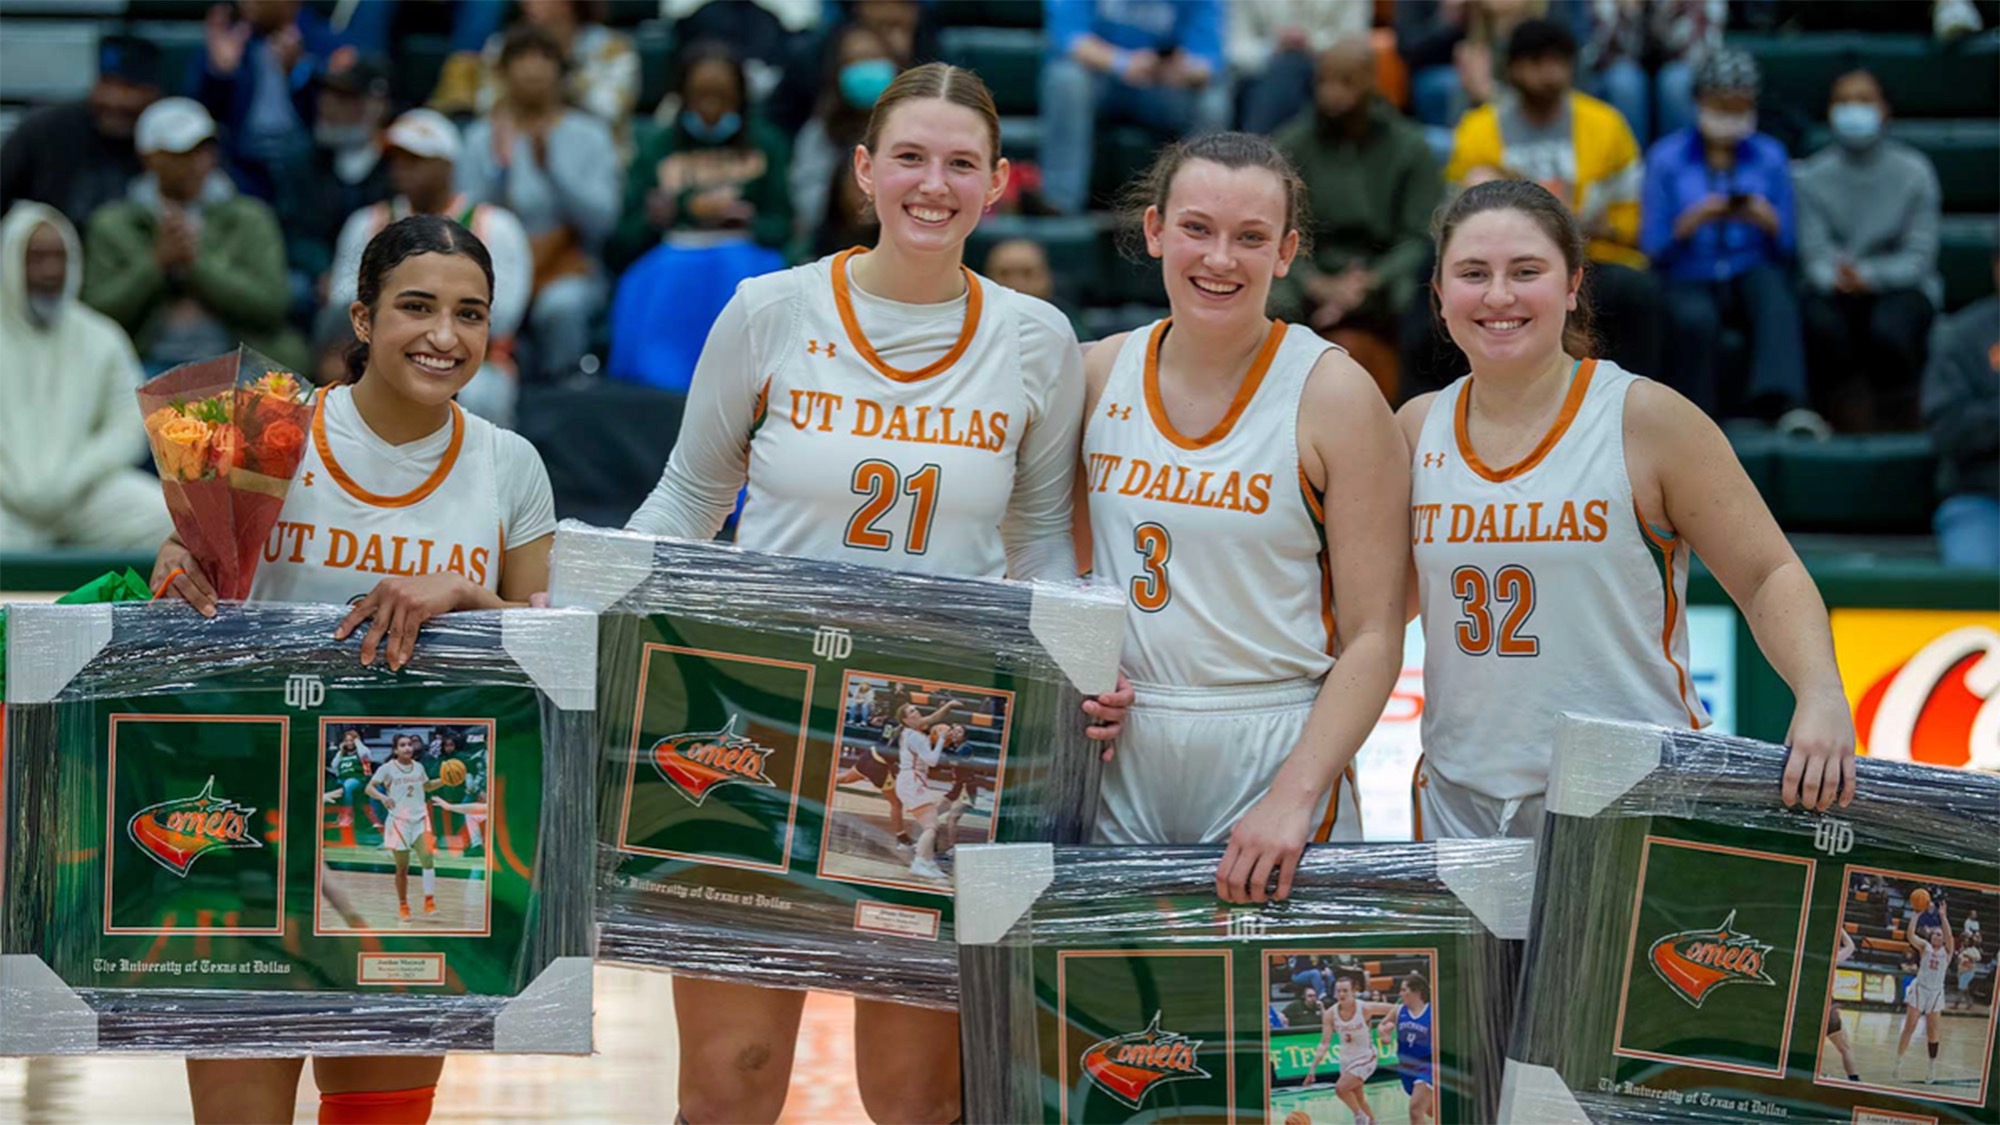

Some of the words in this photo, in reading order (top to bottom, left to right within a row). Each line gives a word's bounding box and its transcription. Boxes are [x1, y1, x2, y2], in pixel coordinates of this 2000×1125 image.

[789, 389, 842, 431] UT
[851, 398, 1009, 452] DALLAS
[843, 458, 942, 556] 21
[1118, 459, 1274, 515] DALLAS
[1447, 499, 1609, 543] DALLAS
[263, 521, 315, 564] UT
[323, 527, 490, 587] DALLAS
[1130, 521, 1172, 613] 3
[1451, 564, 1540, 657] 32
[812, 625, 853, 661] UTD
[284, 674, 325, 710] UTD
[1814, 818, 1854, 856] UTD
[603, 873, 626, 888] The
[629, 876, 688, 899] University
[690, 886, 703, 898] of
[704, 886, 739, 903] Texas
[741, 893, 754, 906] at
[756, 893, 792, 910] Dallas
[93, 958, 116, 974] The
[119, 958, 182, 975] University
[184, 959, 198, 973] of
[200, 959, 236, 973] Texas
[239, 961, 250, 973] at
[253, 960, 291, 974] Dallas
[1598, 1077, 1620, 1093] The
[1623, 1080, 1683, 1105] University
[1685, 1091, 1698, 1105] of
[1699, 1092, 1736, 1110] Texas
[1737, 1100, 1750, 1112] at
[1751, 1099, 1787, 1116] Dallas
